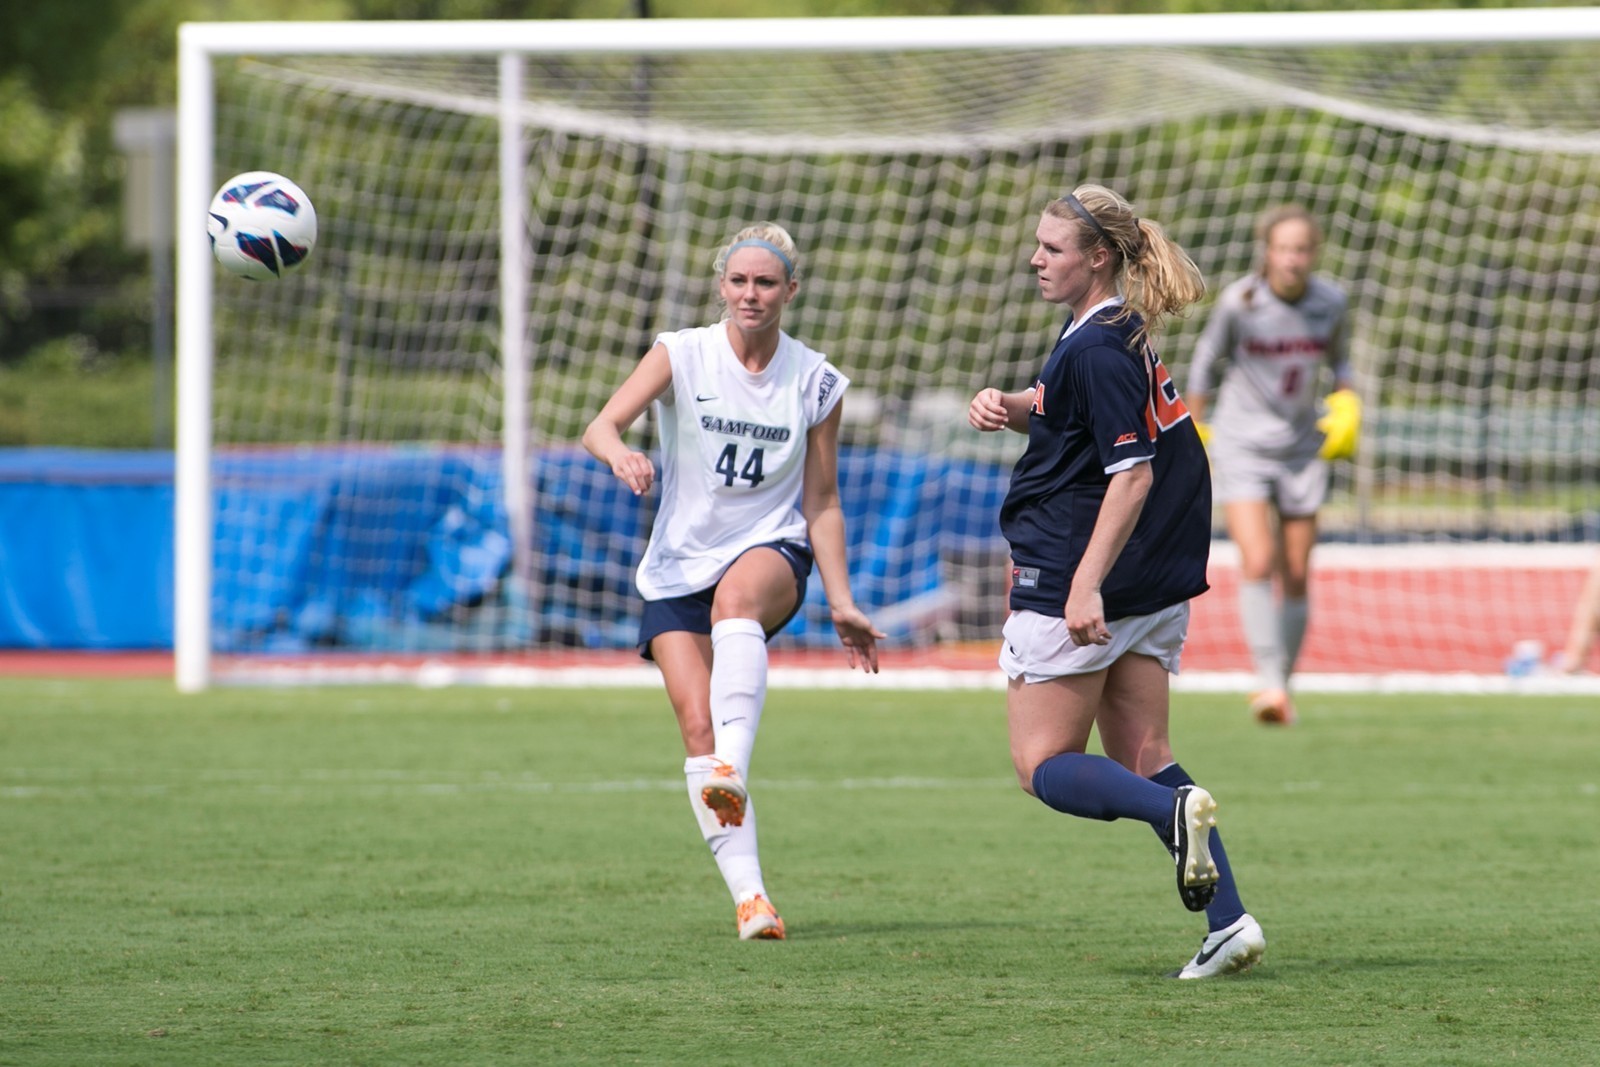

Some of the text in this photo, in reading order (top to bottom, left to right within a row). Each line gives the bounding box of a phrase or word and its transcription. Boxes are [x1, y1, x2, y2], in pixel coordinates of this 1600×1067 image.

[701, 415, 791, 443] SAMFORD
[1115, 432, 1137, 444] ACC
[715, 443, 765, 489] 44
